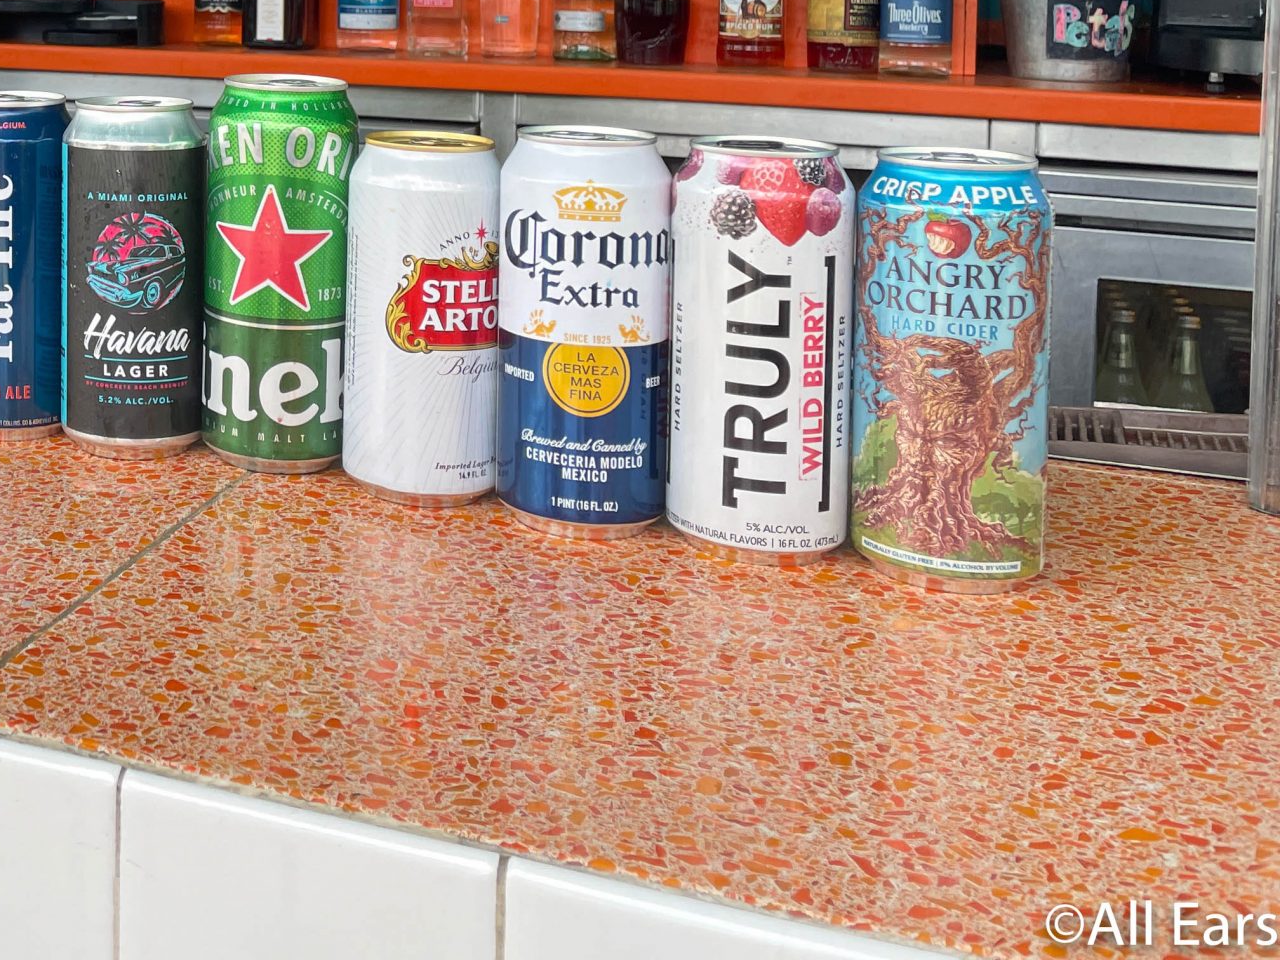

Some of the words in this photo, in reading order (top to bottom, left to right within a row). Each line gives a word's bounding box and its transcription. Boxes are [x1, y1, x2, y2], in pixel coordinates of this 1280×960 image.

[888, 2, 912, 23] Three
[912, 0, 942, 24] Olives
[87, 192, 94, 200] A
[98, 192, 132, 202] MIAMI
[137, 192, 189, 202] ORIGINAL
[873, 175, 942, 201] CRISP
[948, 185, 1038, 205] APPLE
[439, 231, 470, 253] ANNO
[504, 208, 670, 279] Corona
[885, 255, 1007, 290] ANGRY
[538, 267, 640, 309] Extra
[867, 280, 1028, 321] ORCHARD
[83, 312, 192, 359] Havana
[564, 332, 590, 344] SINCE
[593, 334, 612, 345] 1925
[891, 315, 935, 332] HARD
[947, 322, 999, 341] CIDER
[803, 295, 825, 389] BERRY
[836, 315, 846, 392] SELTZER
[552, 362, 620, 377] CERVEZA
[576, 351, 596, 363] LA
[103, 363, 169, 377] LAGER
[504, 363, 535, 383] IMPORTED
[722, 249, 792, 509] TRULY
[5, 384, 31, 400] ALE
[569, 389, 602, 402] FINA
[570, 377, 602, 389] MAS
[98, 395, 122, 405] 5.2%
[125, 395, 174, 405] ALC./VOL.
[835, 399, 843, 448] HARD
[521, 428, 562, 450] Brewed
[564, 438, 591, 452] and
[592, 438, 634, 453] Canned
[634, 440, 647, 457] by
[802, 397, 824, 476] WILD
[526, 445, 596, 469] CERVECERIA
[599, 455, 643, 470] MODELO
[561, 467, 608, 483] MEXICO
